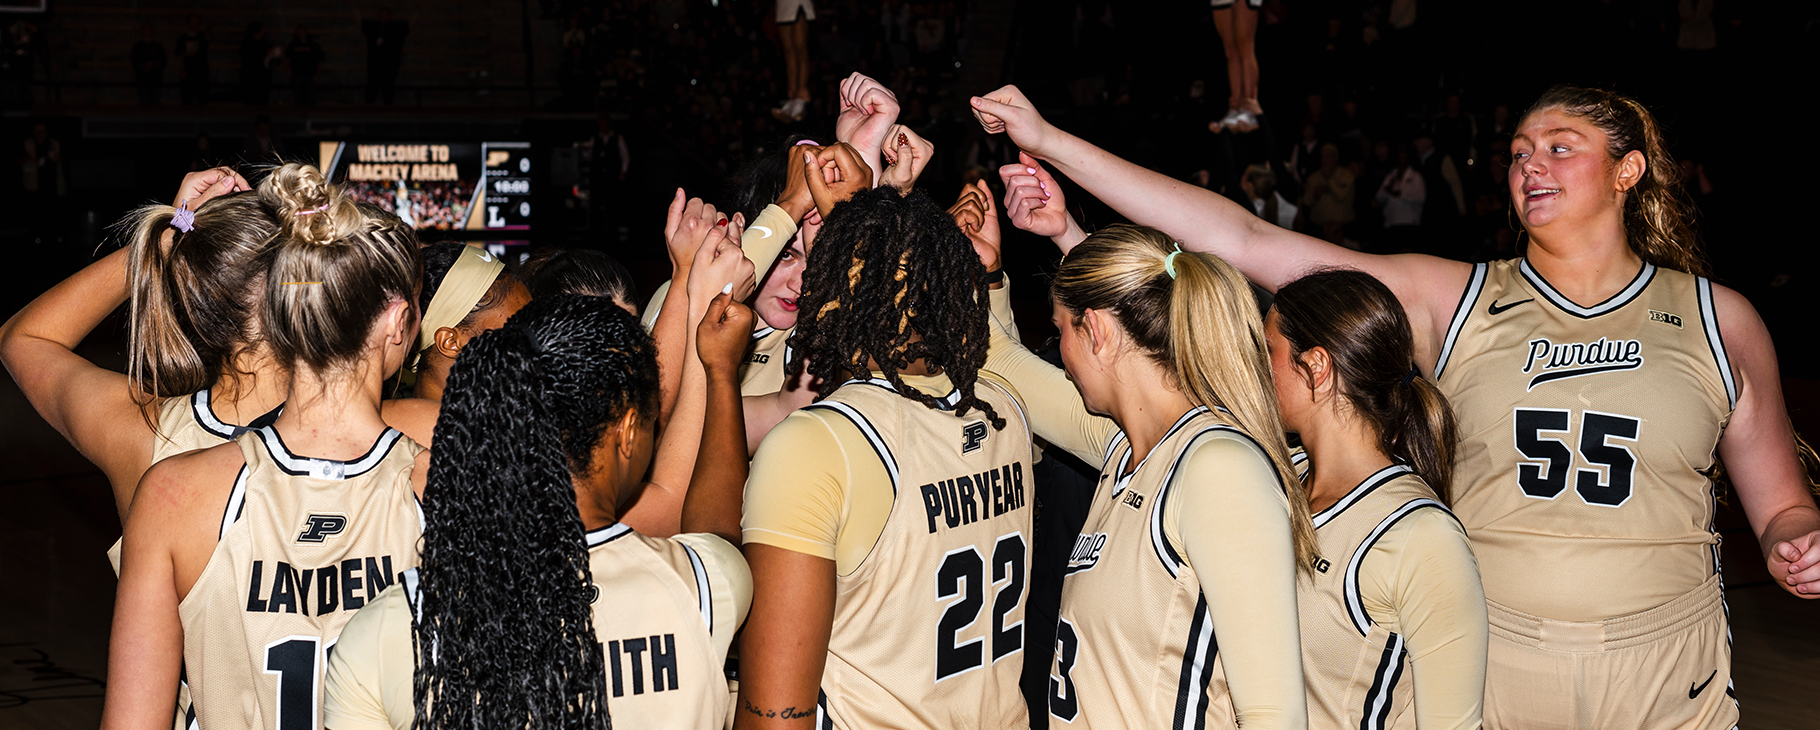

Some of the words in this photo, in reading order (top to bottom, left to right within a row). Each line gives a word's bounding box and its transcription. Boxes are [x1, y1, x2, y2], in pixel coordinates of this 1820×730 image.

[358, 145, 428, 162] WELCOME
[430, 145, 449, 162] TO
[519, 158, 531, 172] 0
[350, 164, 410, 181] MACKEY
[411, 164, 458, 181] ARENA
[494, 180, 530, 193] 10:00
[488, 206, 506, 228] L
[519, 202, 531, 216] 0
[1522, 338, 1643, 376] Purdue
[962, 420, 989, 454] P
[1514, 407, 1641, 508] 55
[920, 461, 1025, 534] PURYEAR
[297, 514, 347, 542] P
[246, 555, 394, 617] LAYDEN
[935, 531, 1027, 684] 22
[262, 634, 342, 730] 1
[600, 633, 679, 698] ITH
